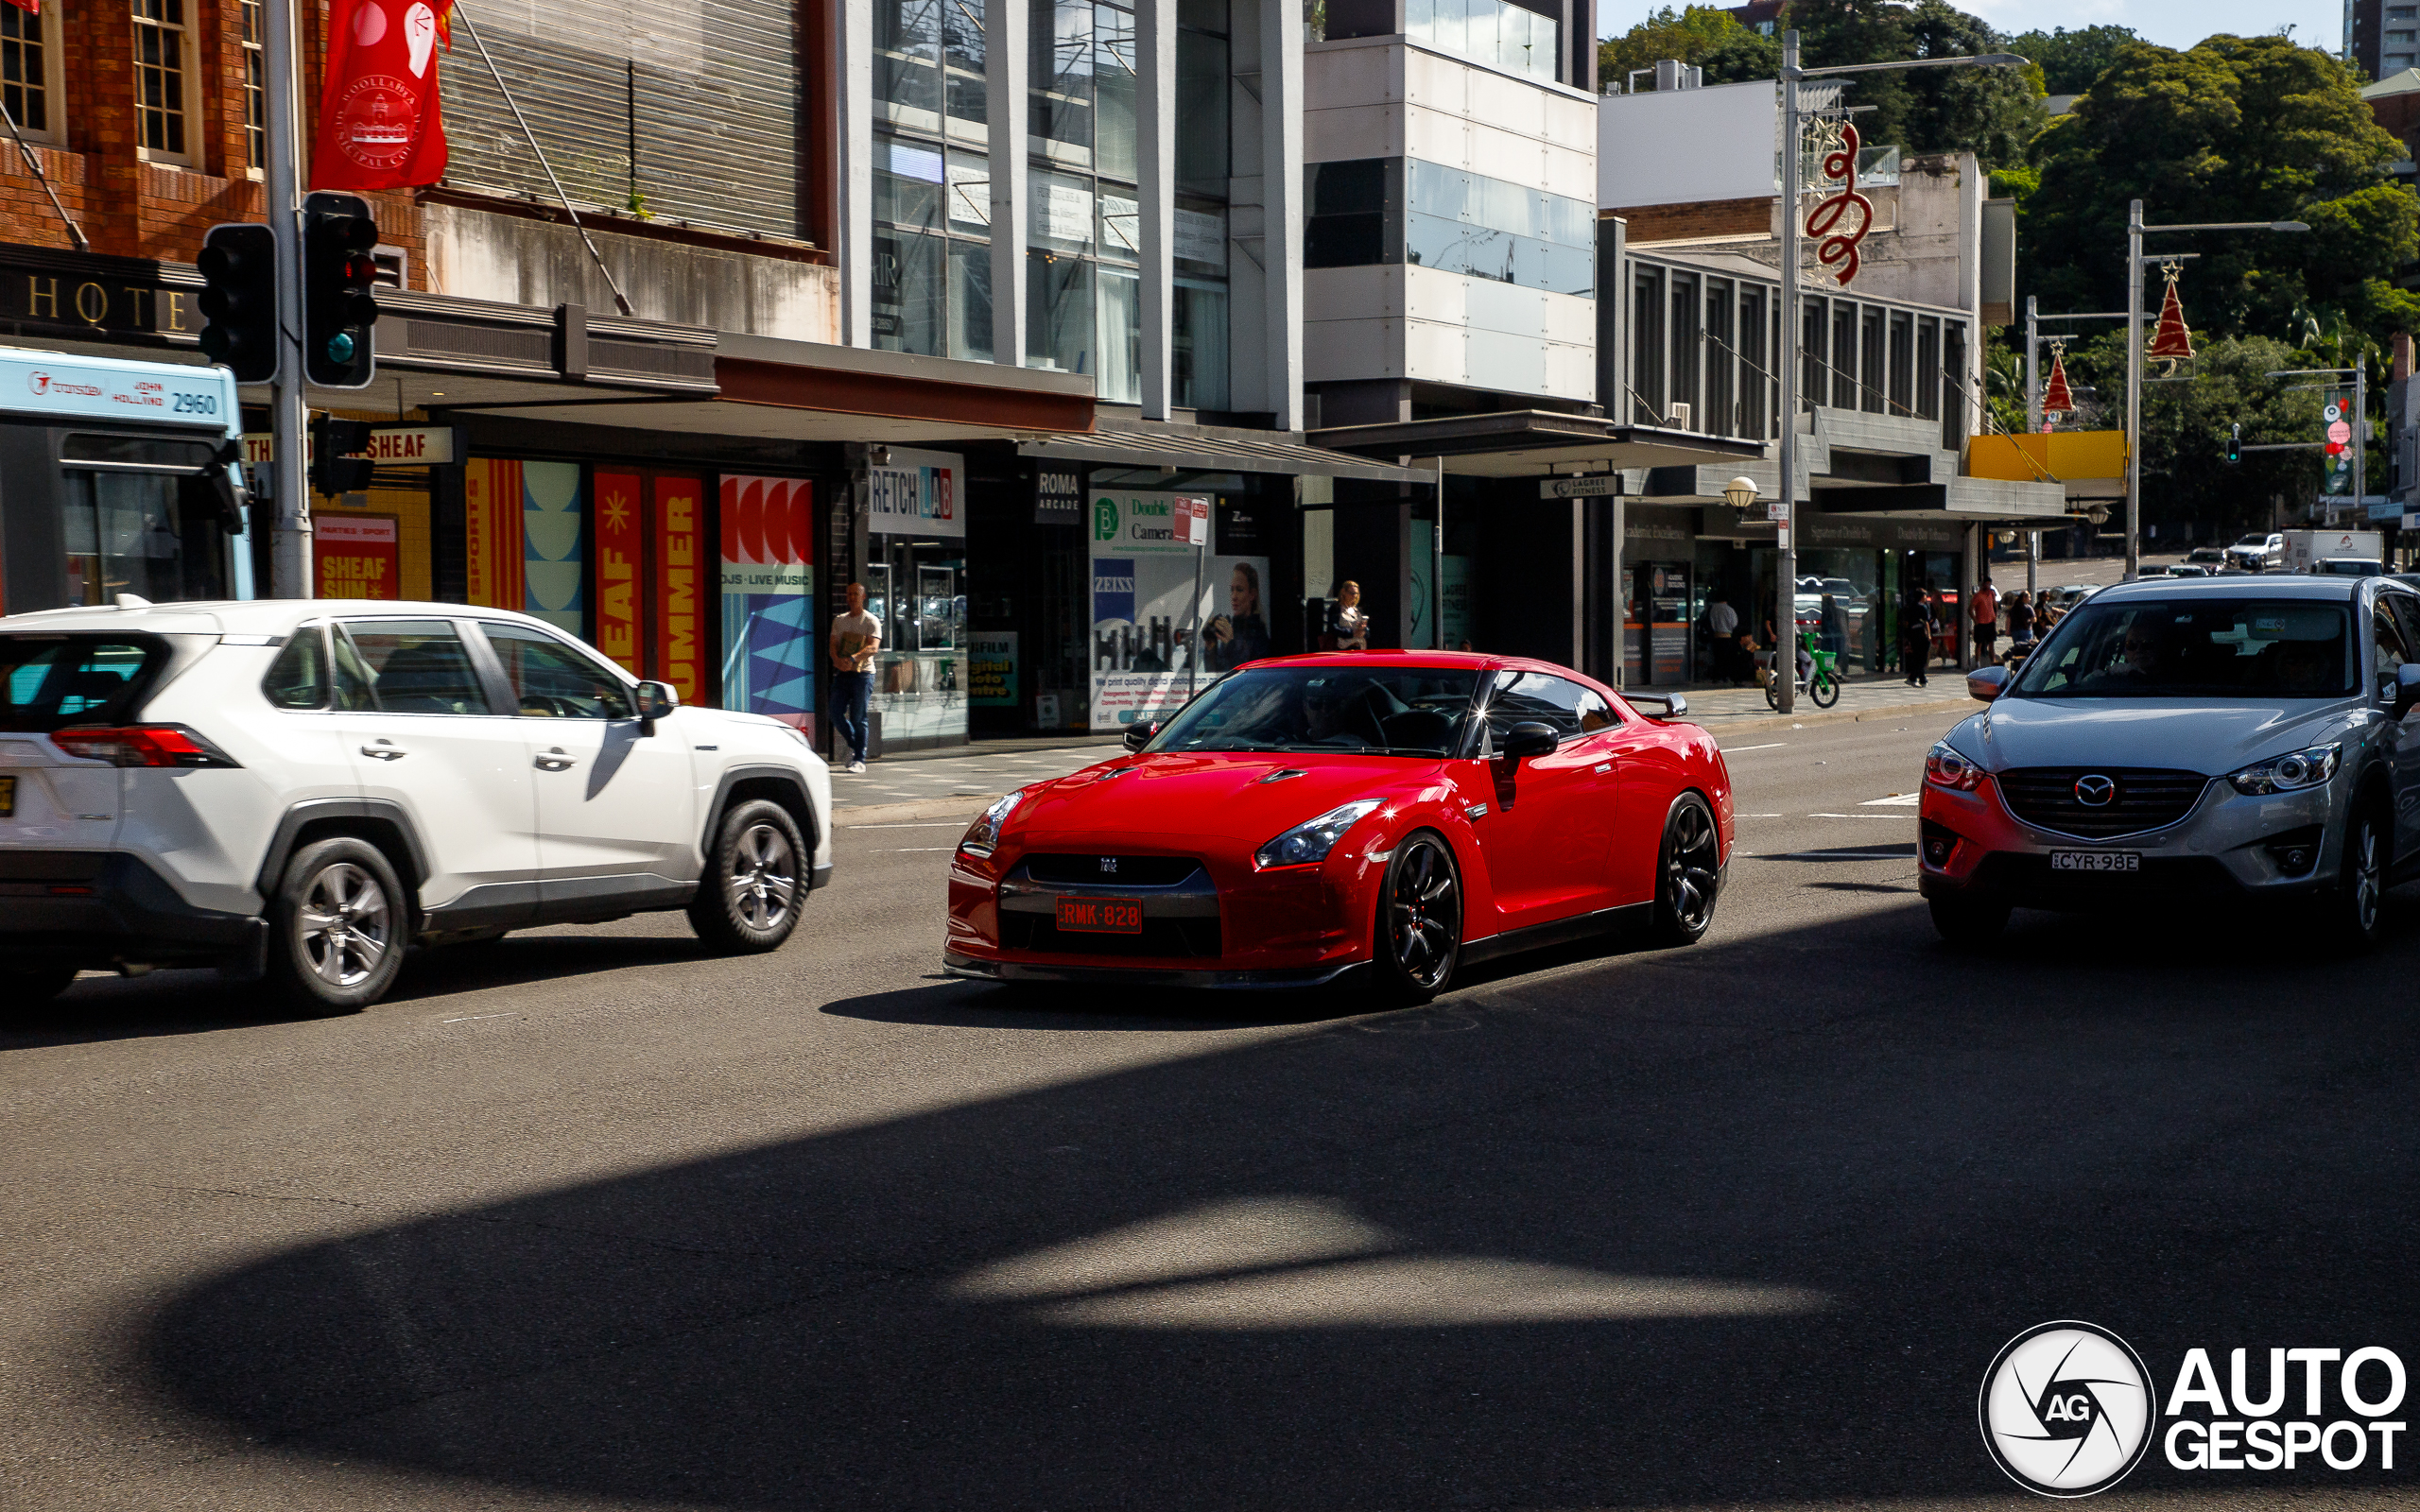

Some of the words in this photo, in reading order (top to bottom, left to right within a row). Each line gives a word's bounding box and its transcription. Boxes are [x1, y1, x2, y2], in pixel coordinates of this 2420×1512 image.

[28, 275, 186, 331] HOTE
[171, 392, 217, 415] 2960
[247, 439, 270, 462] TH
[366, 434, 425, 458] SHEAF
[1040, 473, 1079, 494] ROMA
[1572, 478, 1606, 488] LAGREE
[1572, 487, 1606, 495] FITNESS
[869, 469, 918, 516] RETCH
[1040, 499, 1079, 511] ARCADE
[1132, 498, 1169, 516] Double
[468, 479, 480, 596] SPORTS
[1624, 524, 1651, 539] cademic
[322, 556, 387, 580] SHEAF
[748, 576, 773, 585] LIVE
[775, 575, 809, 585] MUSIC
[1095, 576, 1134, 593] ZEISS
[666, 496, 697, 707] UMMER
[968, 642, 1009, 654] JIFILM
[1095, 678, 1108, 686] We
[1108, 678, 1123, 687] print
[1124, 678, 1147, 687] quality
[1170, 677, 1189, 687] photo
